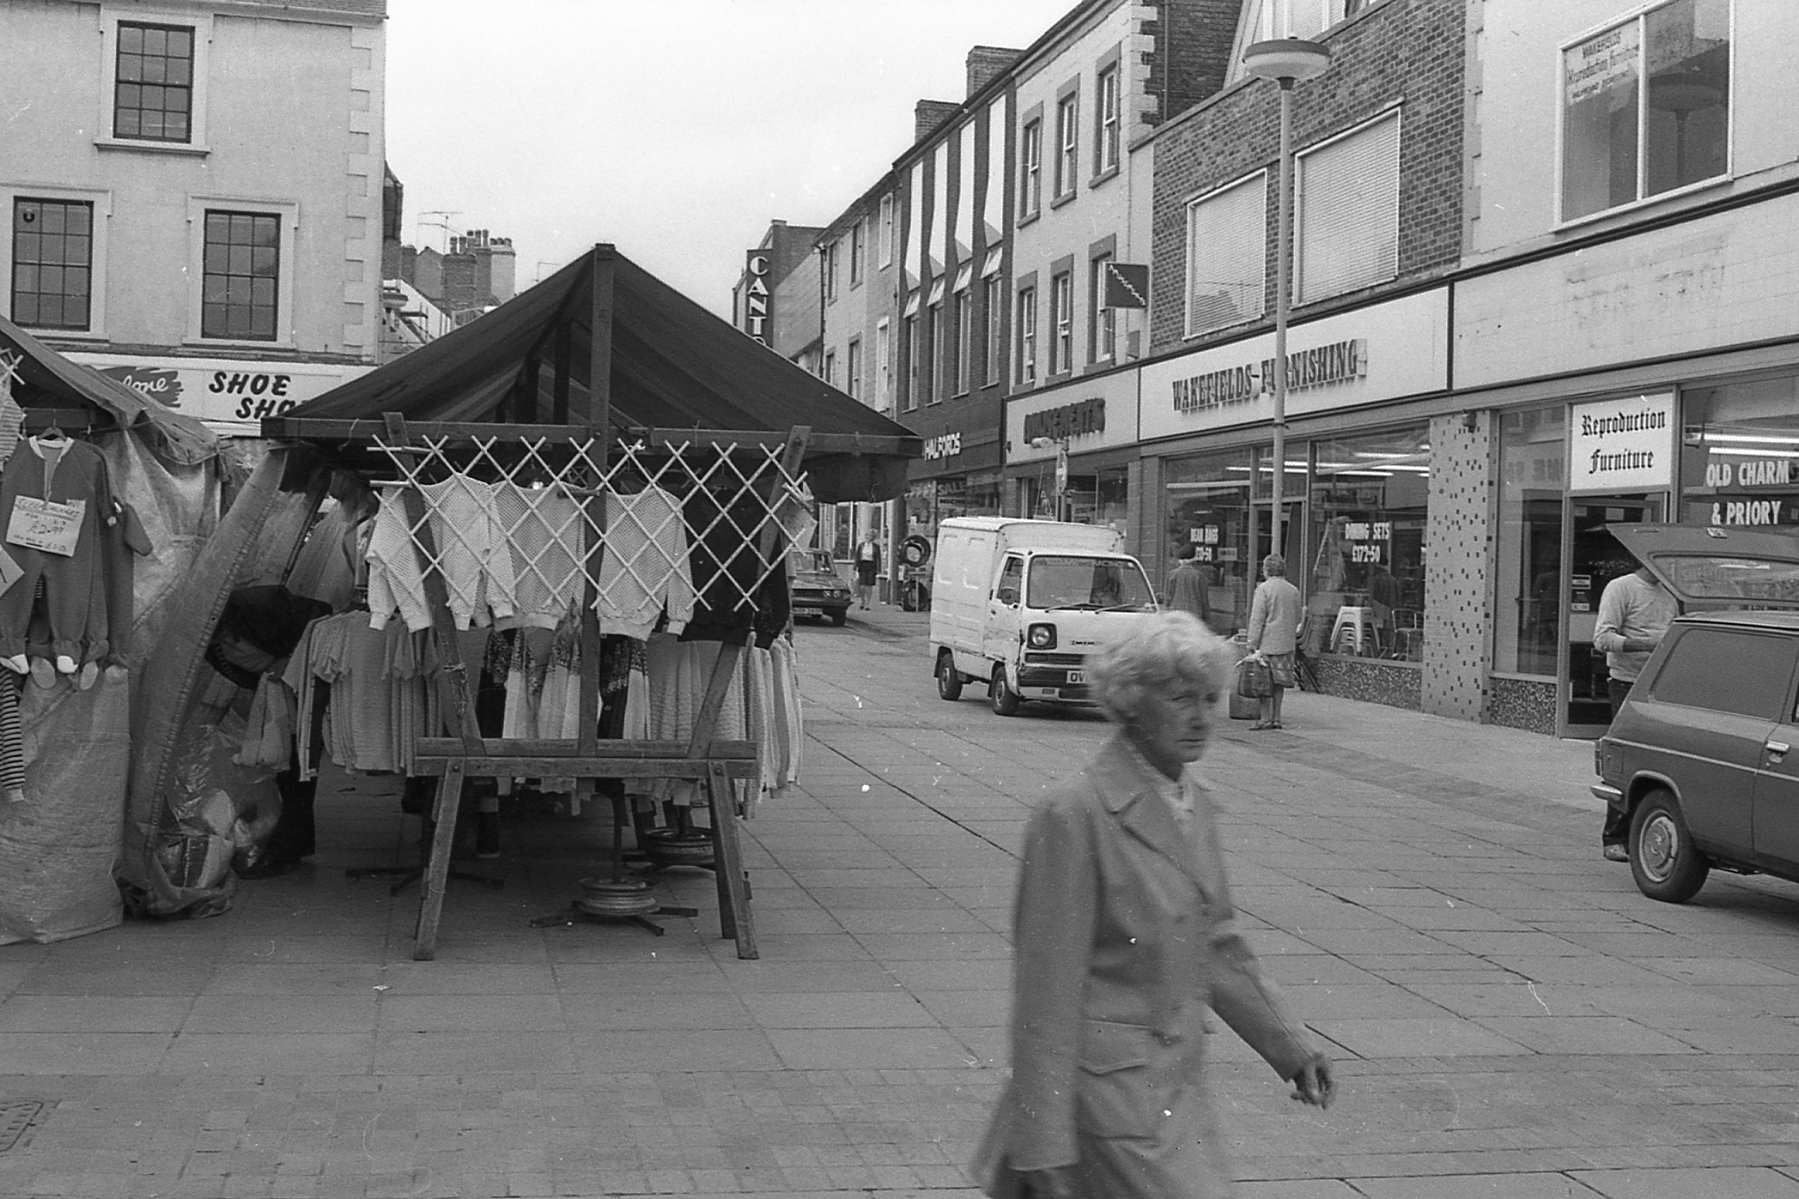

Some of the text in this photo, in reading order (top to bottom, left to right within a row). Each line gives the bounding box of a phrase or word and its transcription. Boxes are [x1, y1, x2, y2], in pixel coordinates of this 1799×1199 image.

[748, 256, 769, 345] CANT
[208, 371, 291, 396] SHOE
[1172, 364, 1256, 411] WAKEFIELDS
[235, 397, 296, 419] SHO
[1582, 408, 1665, 439] Reproduction
[1589, 448, 1654, 475] Furniture
[1706, 460, 1789, 487] OLD CHARM
[1711, 501, 1782, 525] & PRIORY
[1373, 522, 1390, 540] SETS
